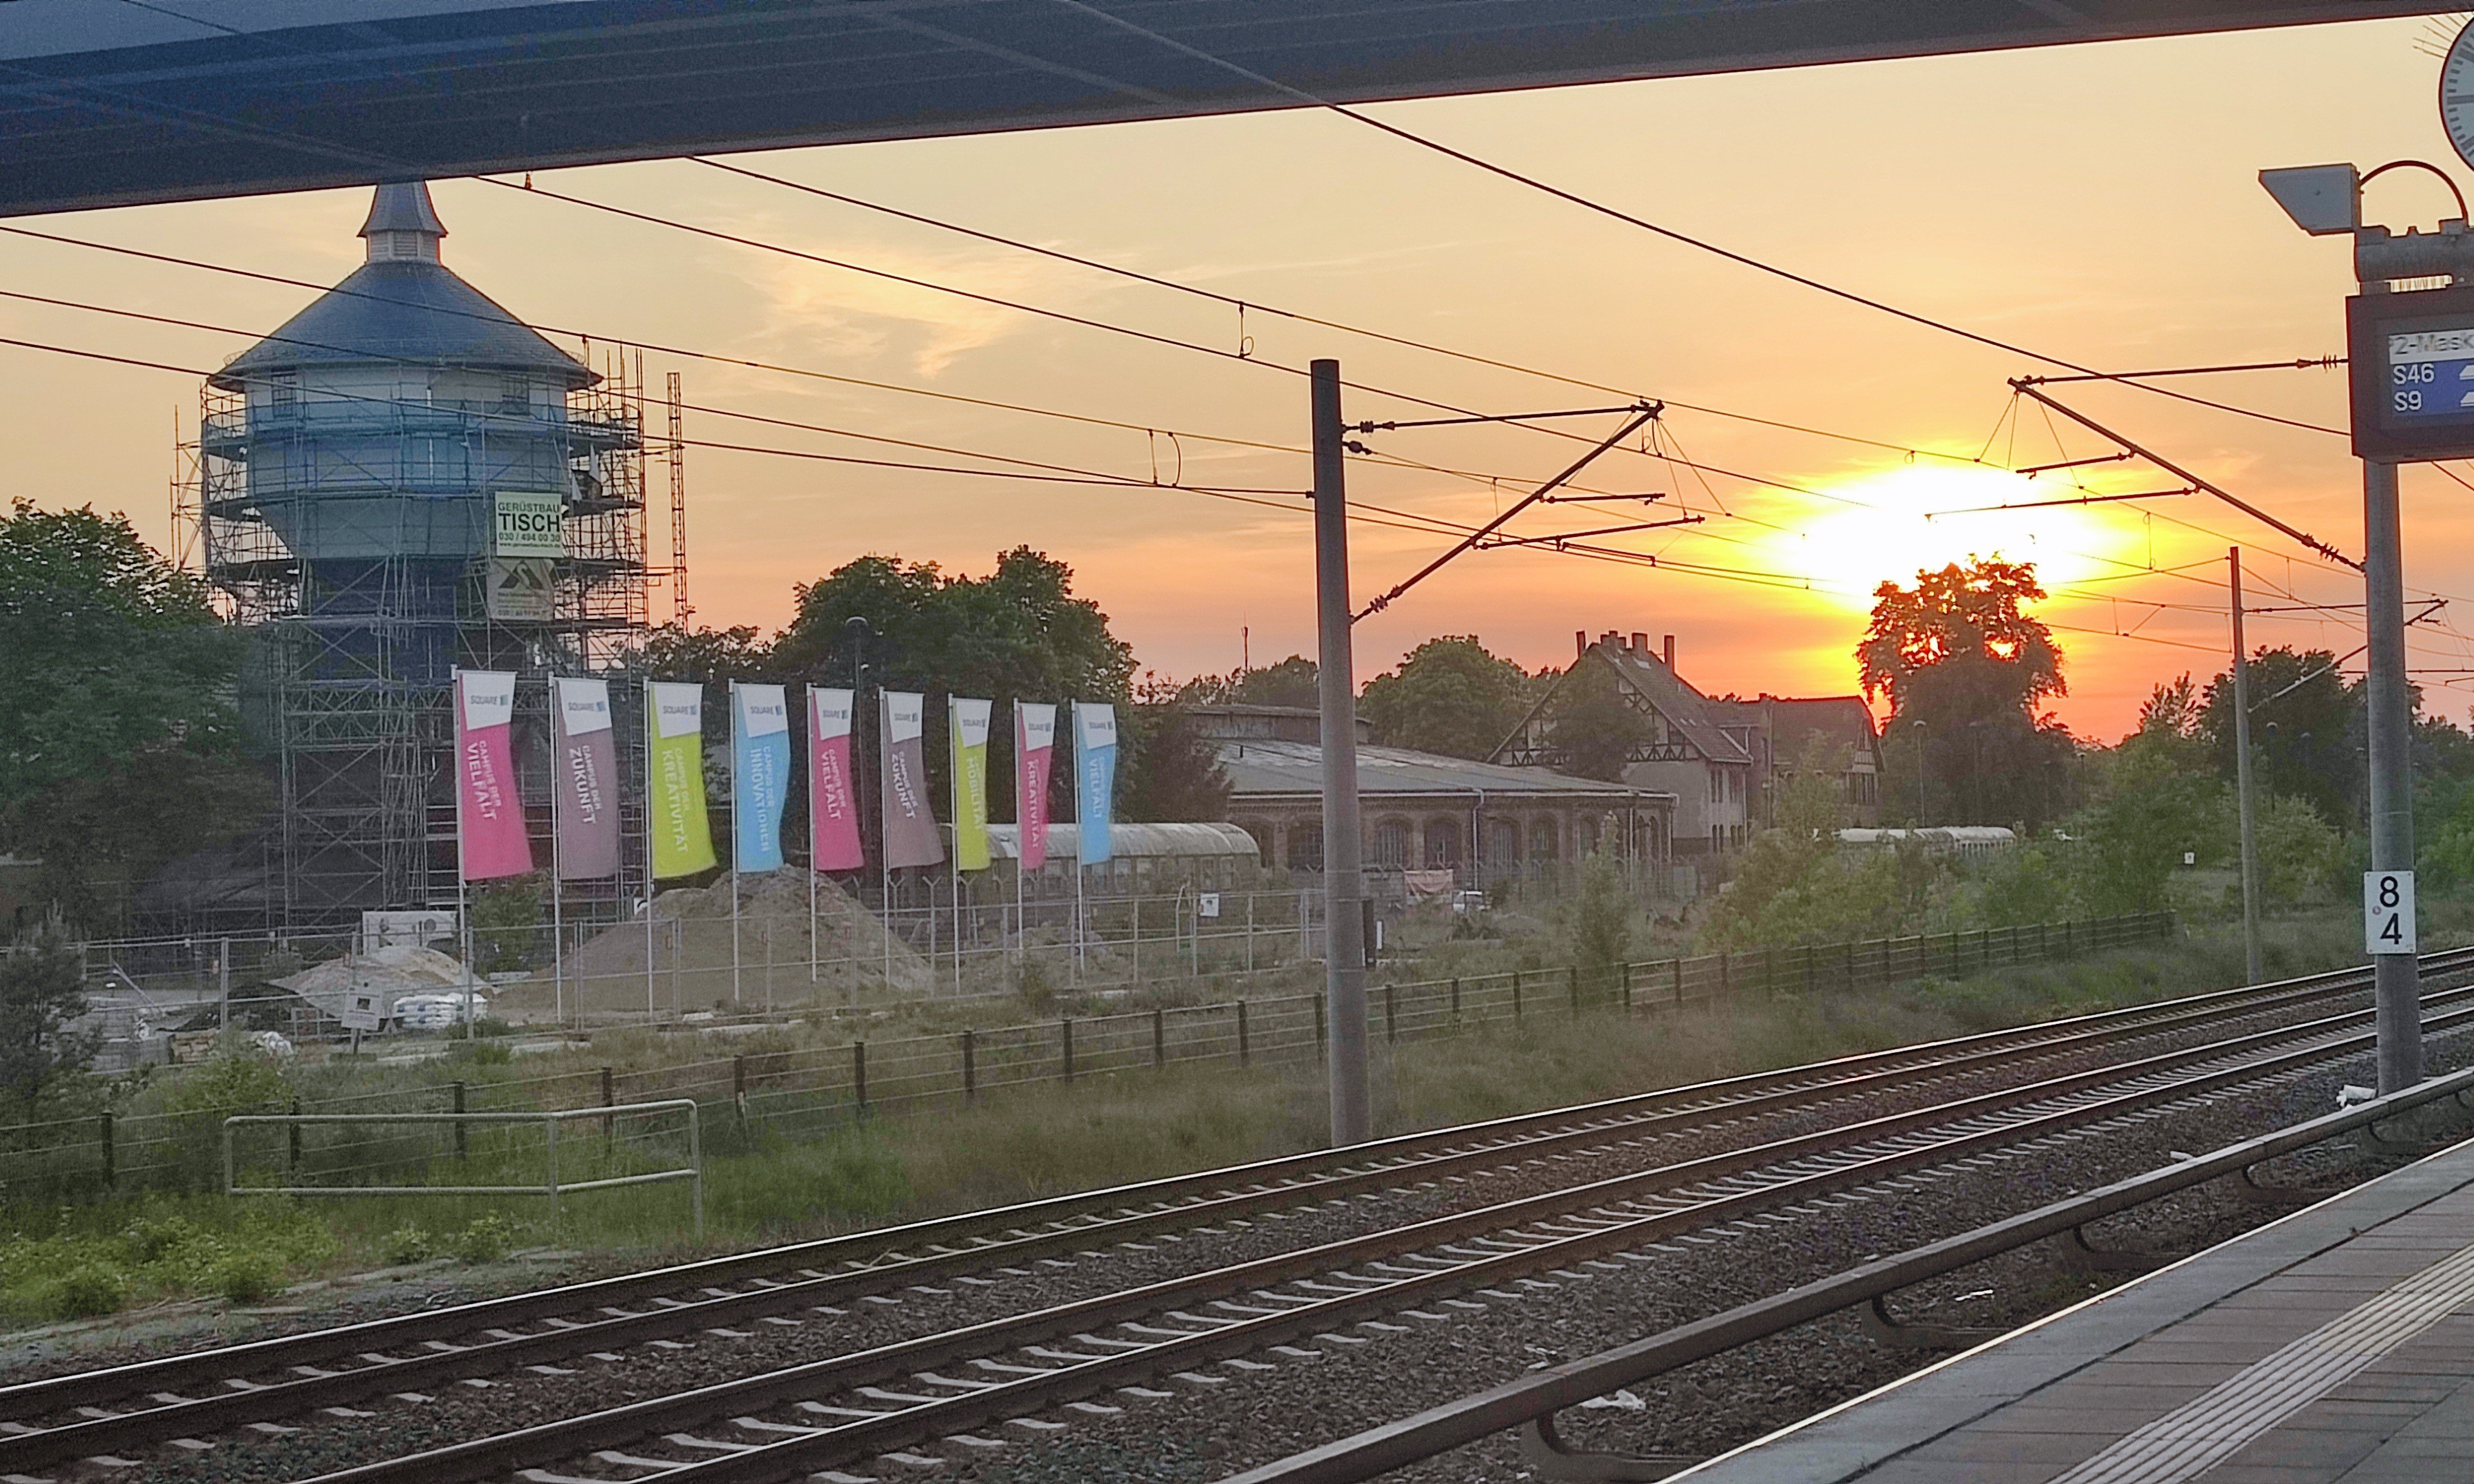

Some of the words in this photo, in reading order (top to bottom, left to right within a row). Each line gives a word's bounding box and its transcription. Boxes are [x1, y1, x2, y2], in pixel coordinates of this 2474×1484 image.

[2393, 363, 2434, 384] S46
[2394, 390, 2422, 412] S9
[498, 501, 559, 512] GERÜSTBAU
[499, 513, 560, 532] TISCH
[499, 532, 514, 541] 030
[467, 743, 497, 820] VIELFALT
[582, 745, 597, 788] CAMPUS
[569, 747, 596, 824] ZUKUNFT
[821, 751, 842, 820] VIELFALT
[892, 753, 916, 819] ZUKUNFT
[2380, 876, 2399, 908] 8
[2380, 912, 2403, 945] 4
